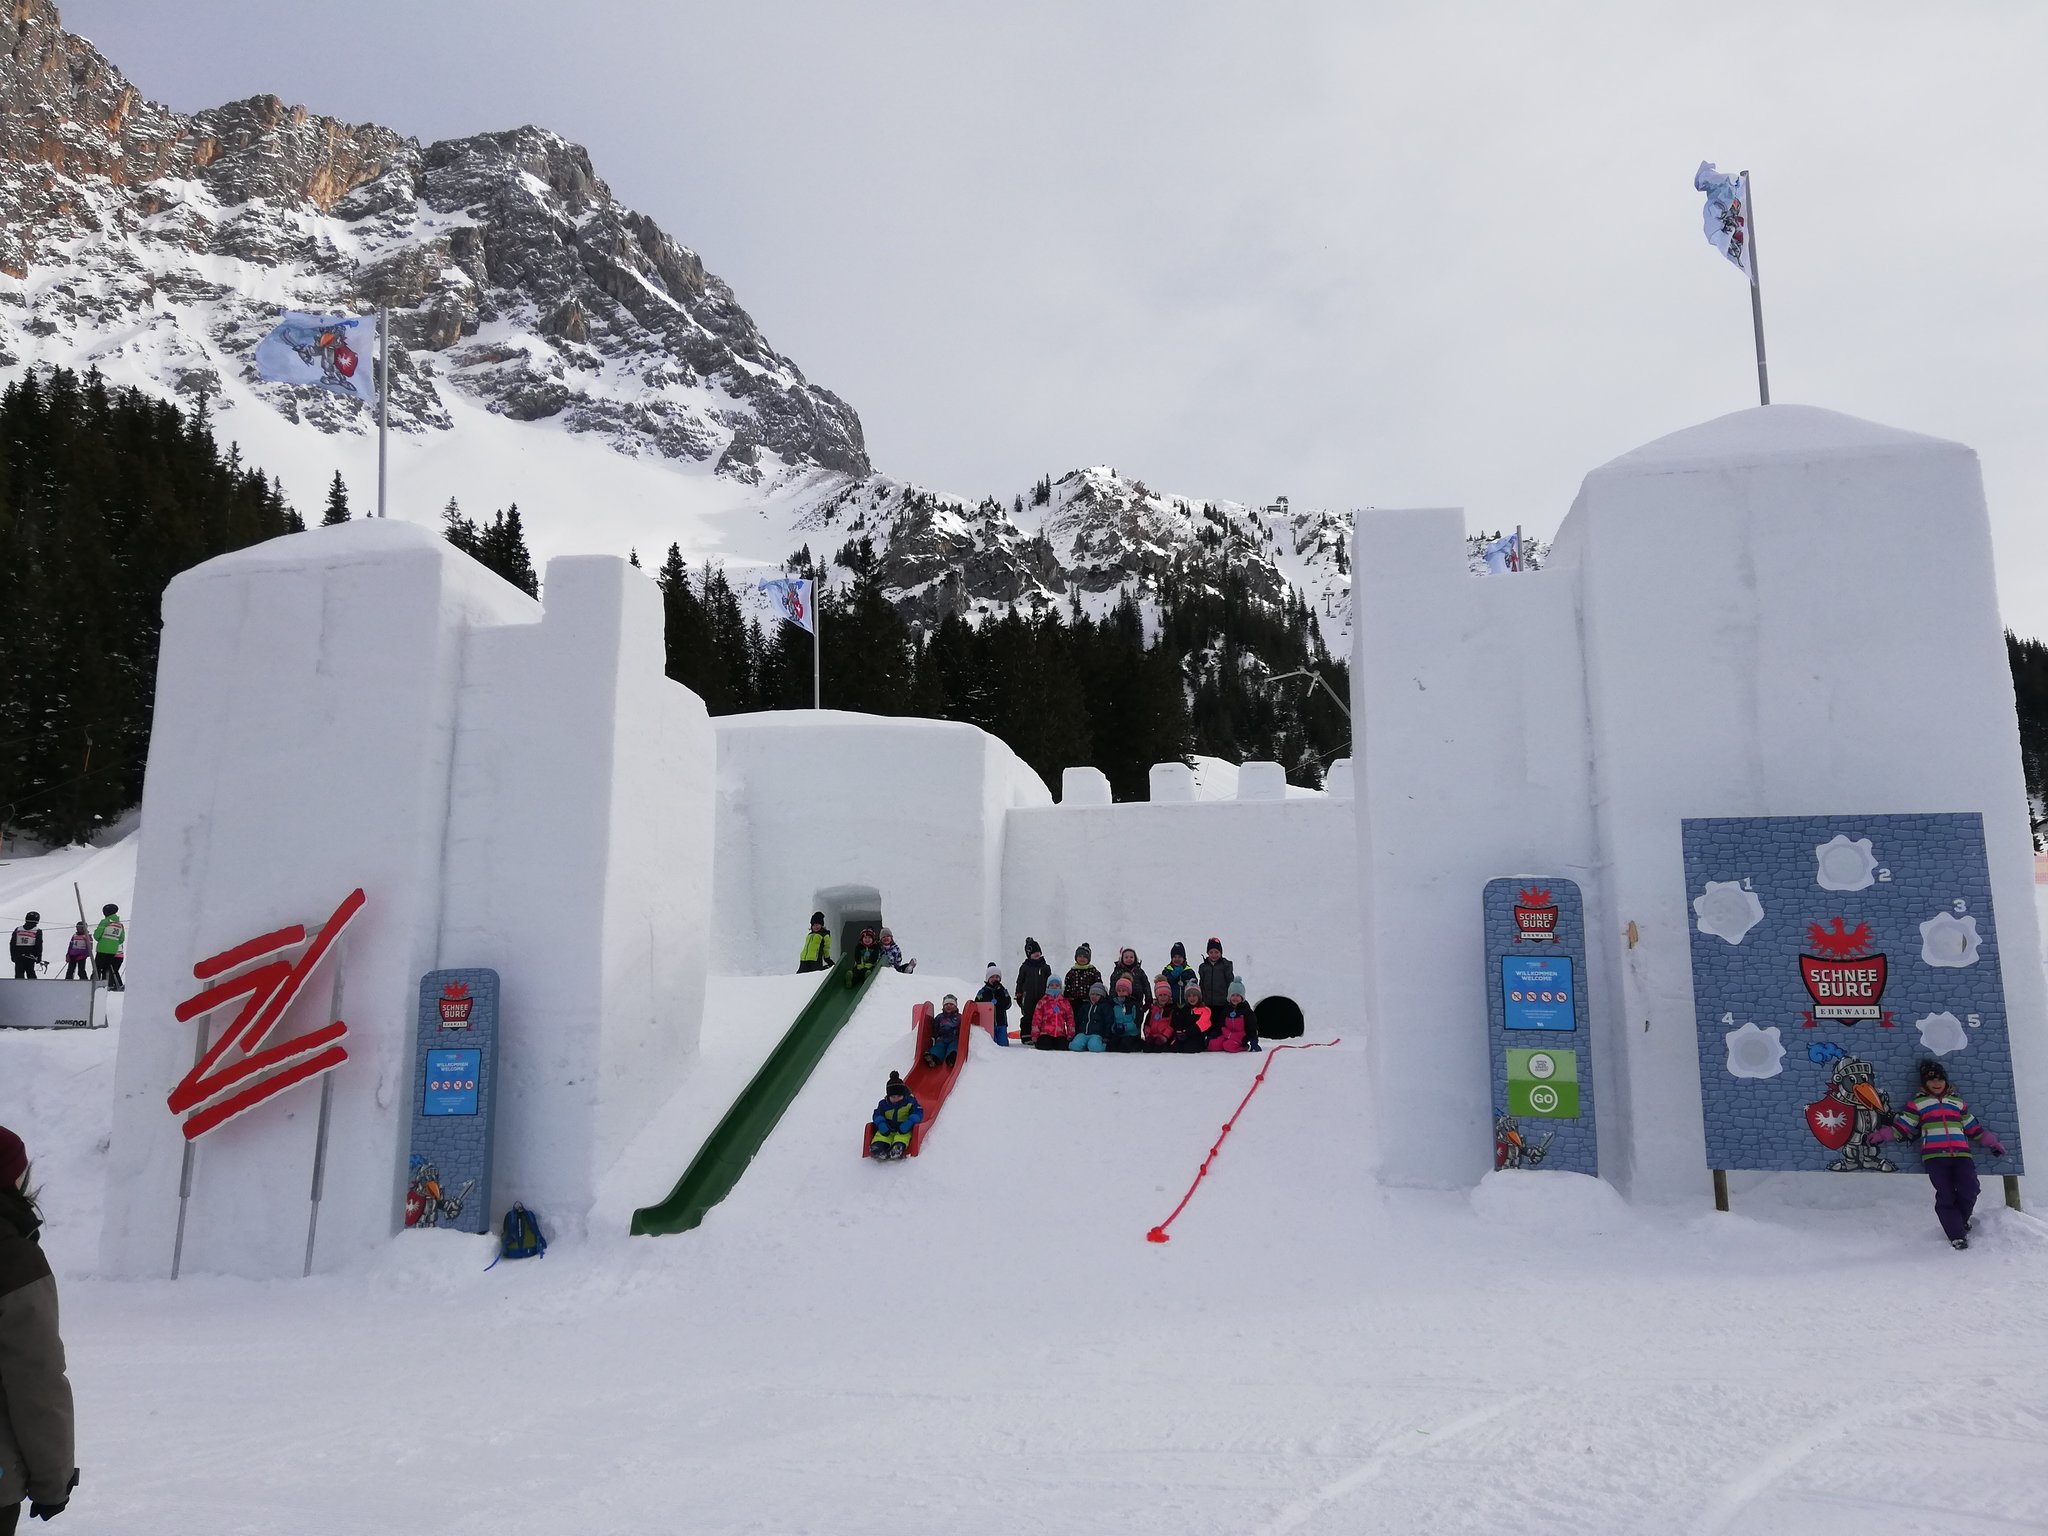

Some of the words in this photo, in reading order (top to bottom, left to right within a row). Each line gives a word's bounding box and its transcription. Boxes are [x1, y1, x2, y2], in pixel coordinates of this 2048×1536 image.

[1879, 868, 1892, 881] 2
[1743, 877, 1753, 890] 1
[1953, 899, 1966, 912] 3
[1523, 920, 1551, 928] BURG
[1810, 969, 1878, 982] SCHNEE
[1818, 982, 1873, 997] BURG
[444, 1010, 466, 1018] BURG
[1721, 1012, 1735, 1025] 4
[1968, 1014, 1981, 1028] 5
[1534, 1093, 1554, 1104] GO
